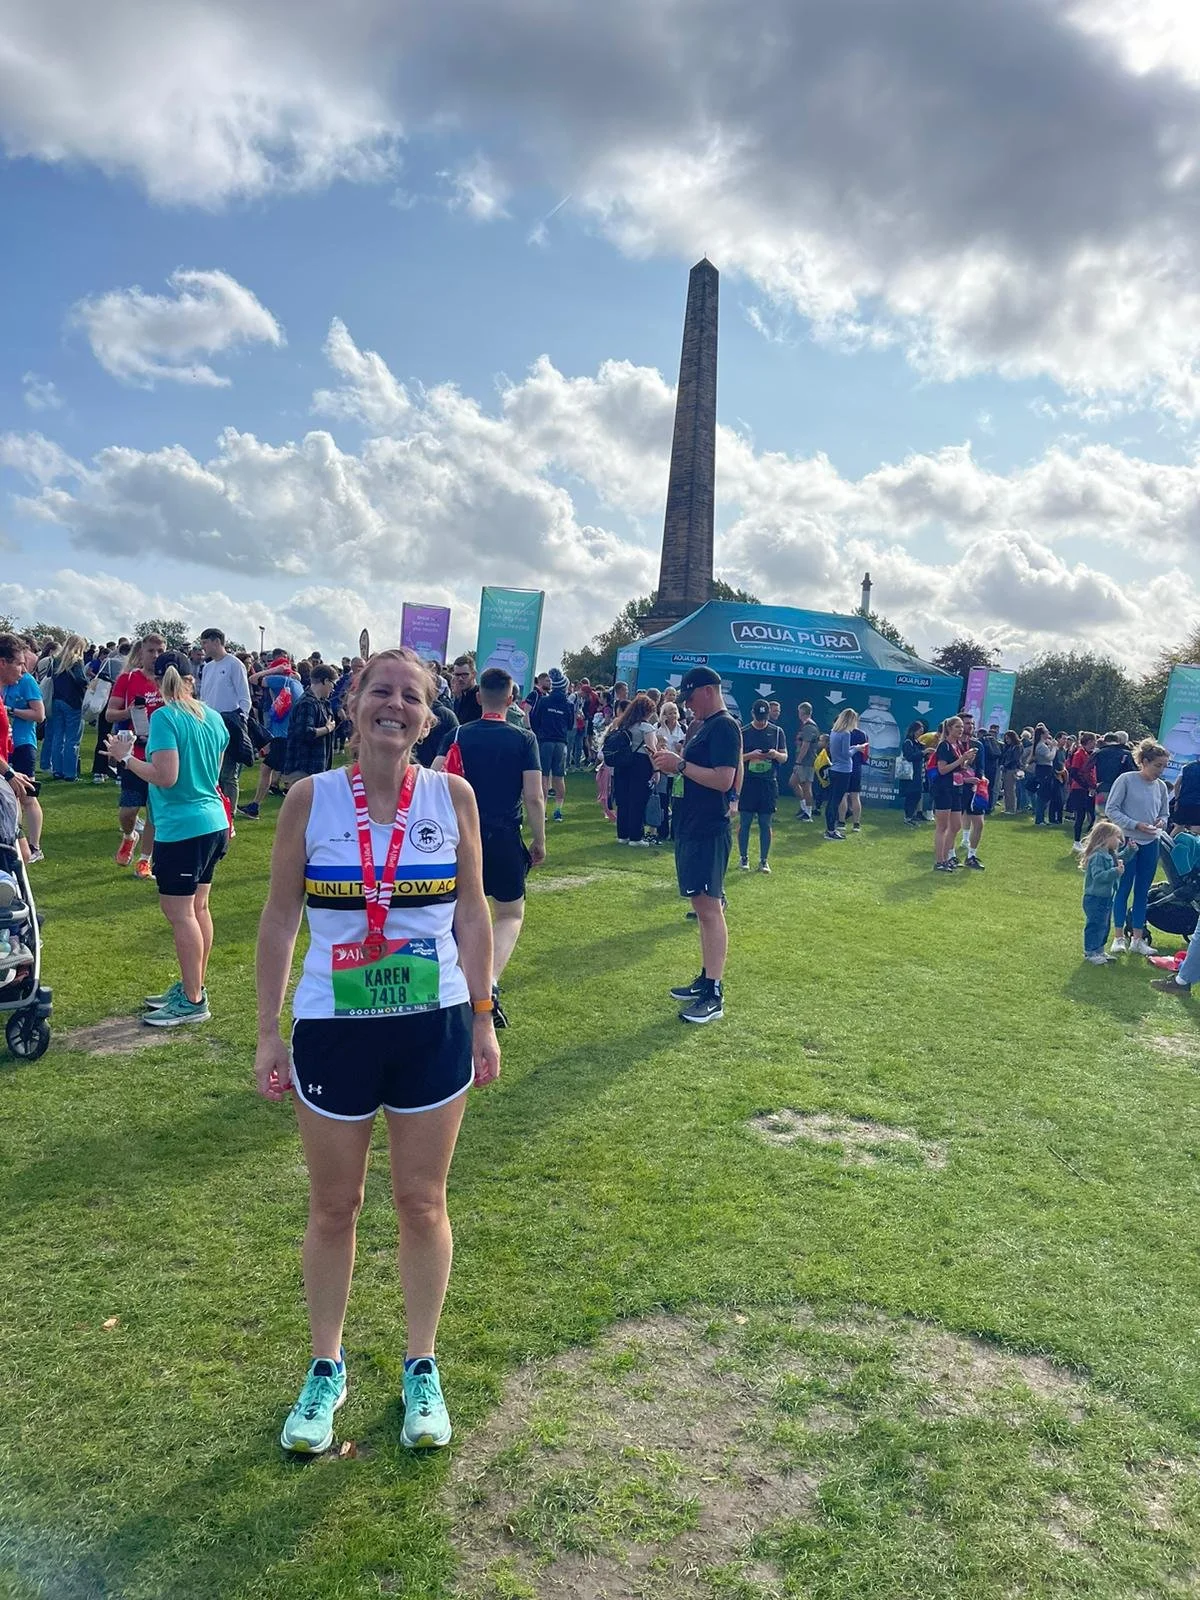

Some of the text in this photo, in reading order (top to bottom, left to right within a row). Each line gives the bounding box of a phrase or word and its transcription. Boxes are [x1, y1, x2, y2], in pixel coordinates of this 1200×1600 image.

[740, 626, 852, 648] AQUA PURA
[738, 659, 867, 682] RECYCLE YOUR BOTTLE HERE
[870, 760, 888, 768] PURA
[314, 880, 452, 896] LINLITOW AC
[364, 966, 410, 987] KAREN
[370, 986, 407, 1006] 7418
[349, 1006, 403, 1015] GOODMOVE
